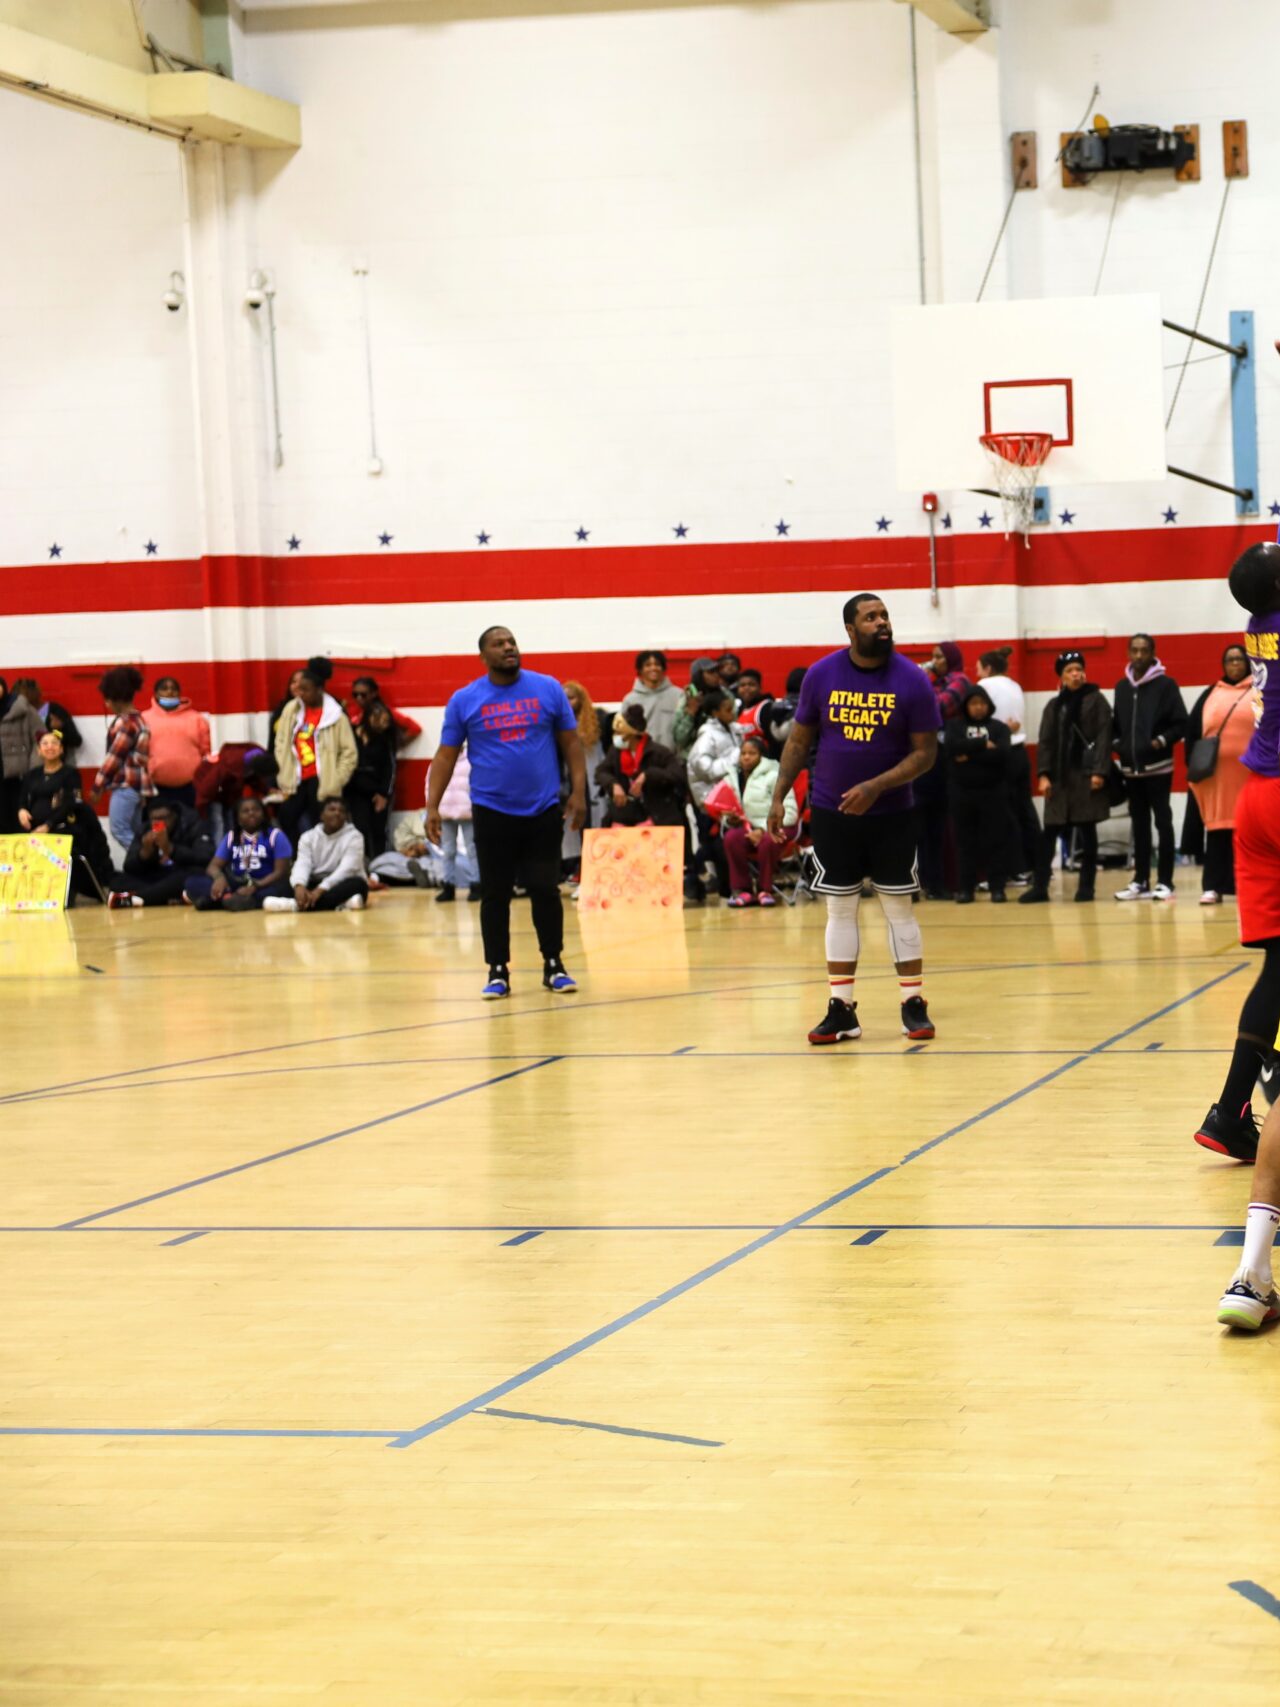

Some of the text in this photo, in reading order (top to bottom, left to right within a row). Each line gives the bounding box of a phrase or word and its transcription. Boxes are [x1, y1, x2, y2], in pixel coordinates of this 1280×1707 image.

[481, 697, 541, 718] ATHLETE
[829, 690, 896, 709] ATHLETE
[483, 712, 539, 731] LEGACY
[829, 707, 892, 726] LEGACY
[843, 725, 875, 742] DAY
